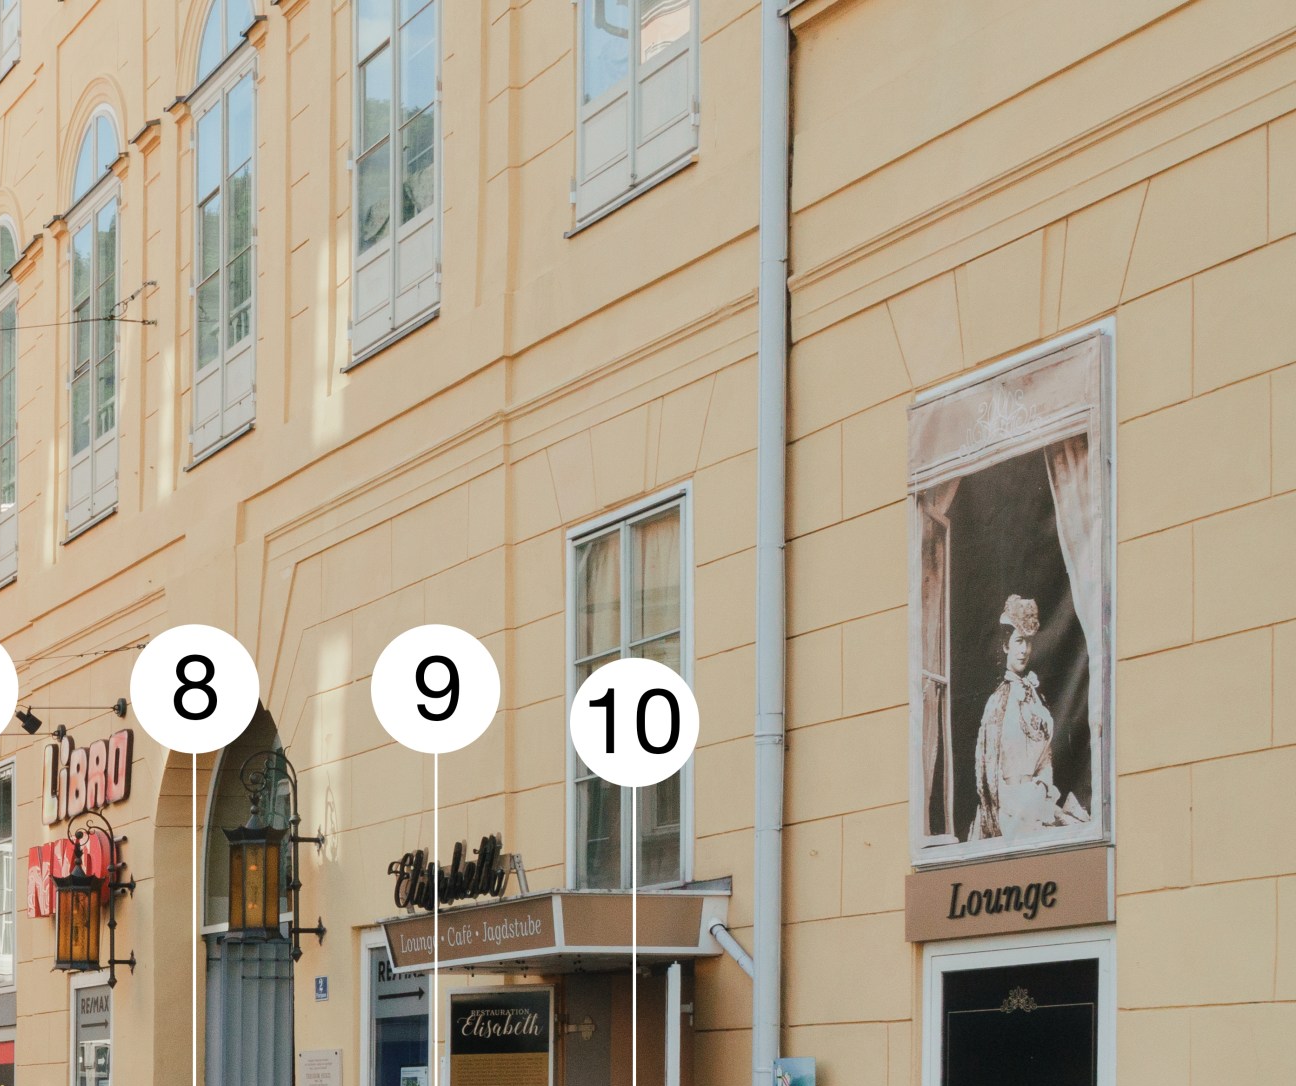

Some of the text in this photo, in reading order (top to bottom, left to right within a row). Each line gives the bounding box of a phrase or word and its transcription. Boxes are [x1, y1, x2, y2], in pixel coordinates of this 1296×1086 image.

[947, 876, 1058, 921] Lounge
[447, 924, 473, 947] Café
[482, 915, 542, 946] Jagdstube
[80, 995, 110, 1015] RE/MAX
[470, 1008, 530, 1017] RESTAURATION
[457, 1011, 543, 1039] Elisabeth
